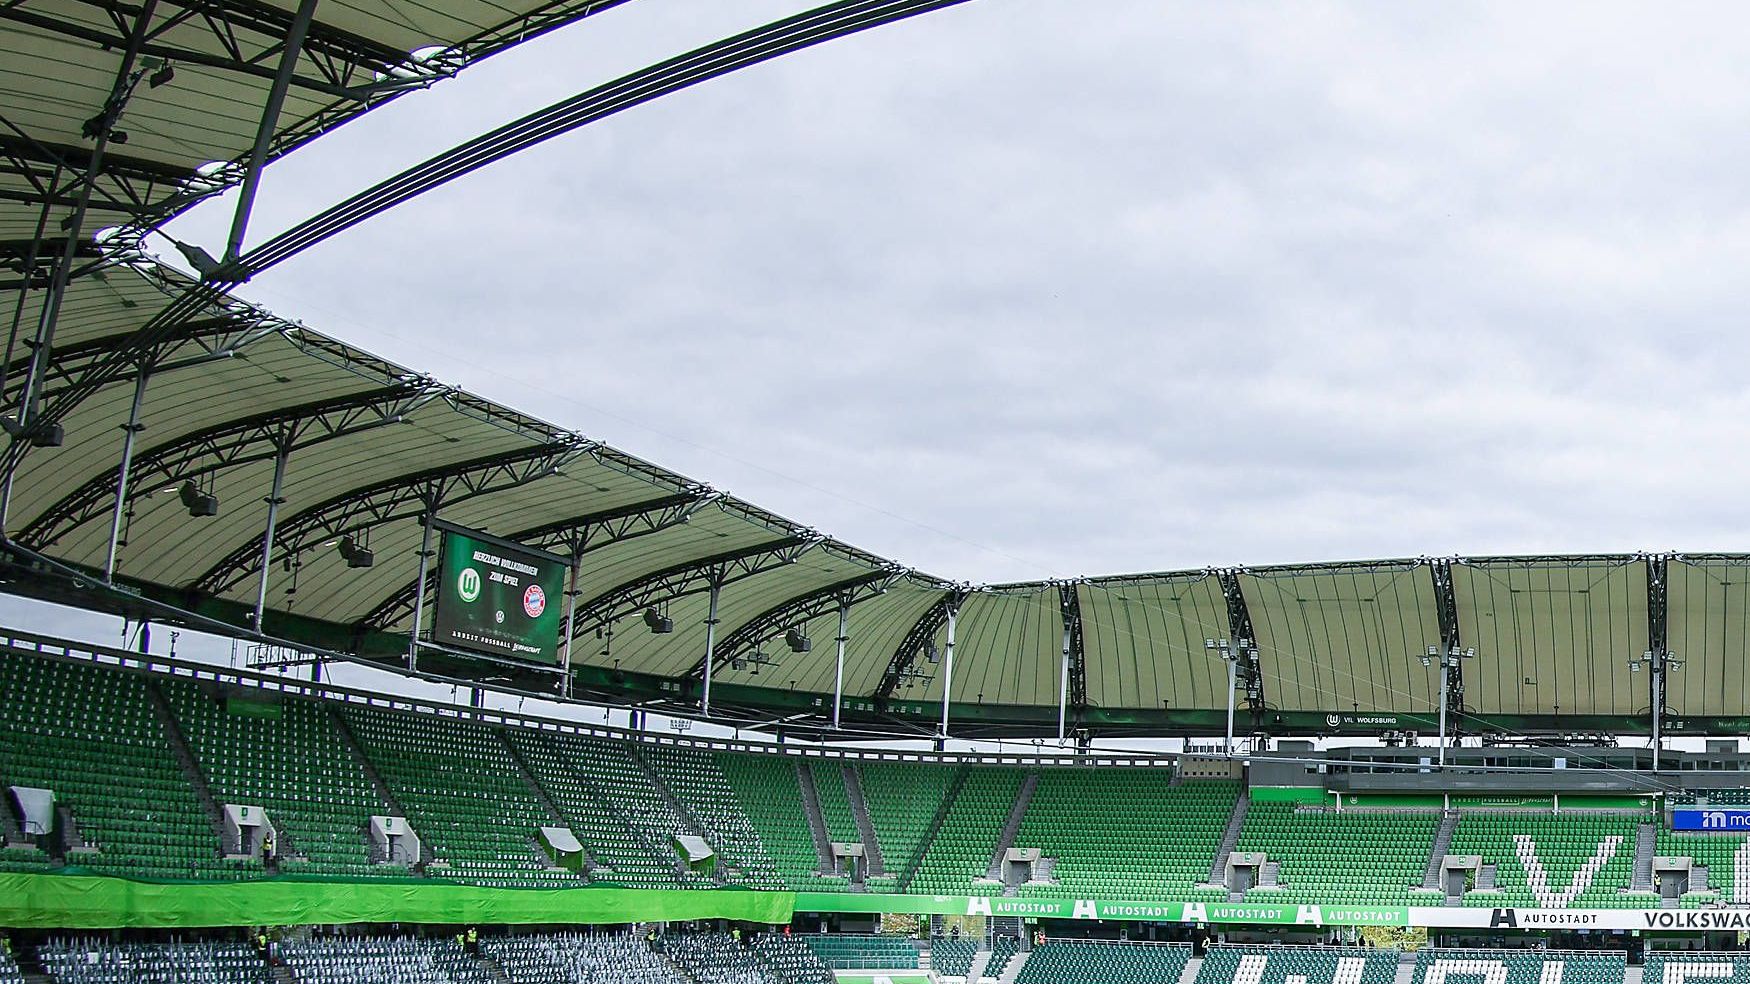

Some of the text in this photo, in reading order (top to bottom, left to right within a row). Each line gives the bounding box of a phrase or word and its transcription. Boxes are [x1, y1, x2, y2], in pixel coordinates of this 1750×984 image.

[489, 571, 519, 587] ZUM SPIEL
[996, 902, 1060, 915] AUTOSTADT
[1103, 905, 1169, 917] AUTOSTADT
[1213, 907, 1283, 920] AUTOSTADT
[1328, 910, 1401, 921] AUTOSTADT
[1524, 914, 1597, 924] AUTOSTADT
